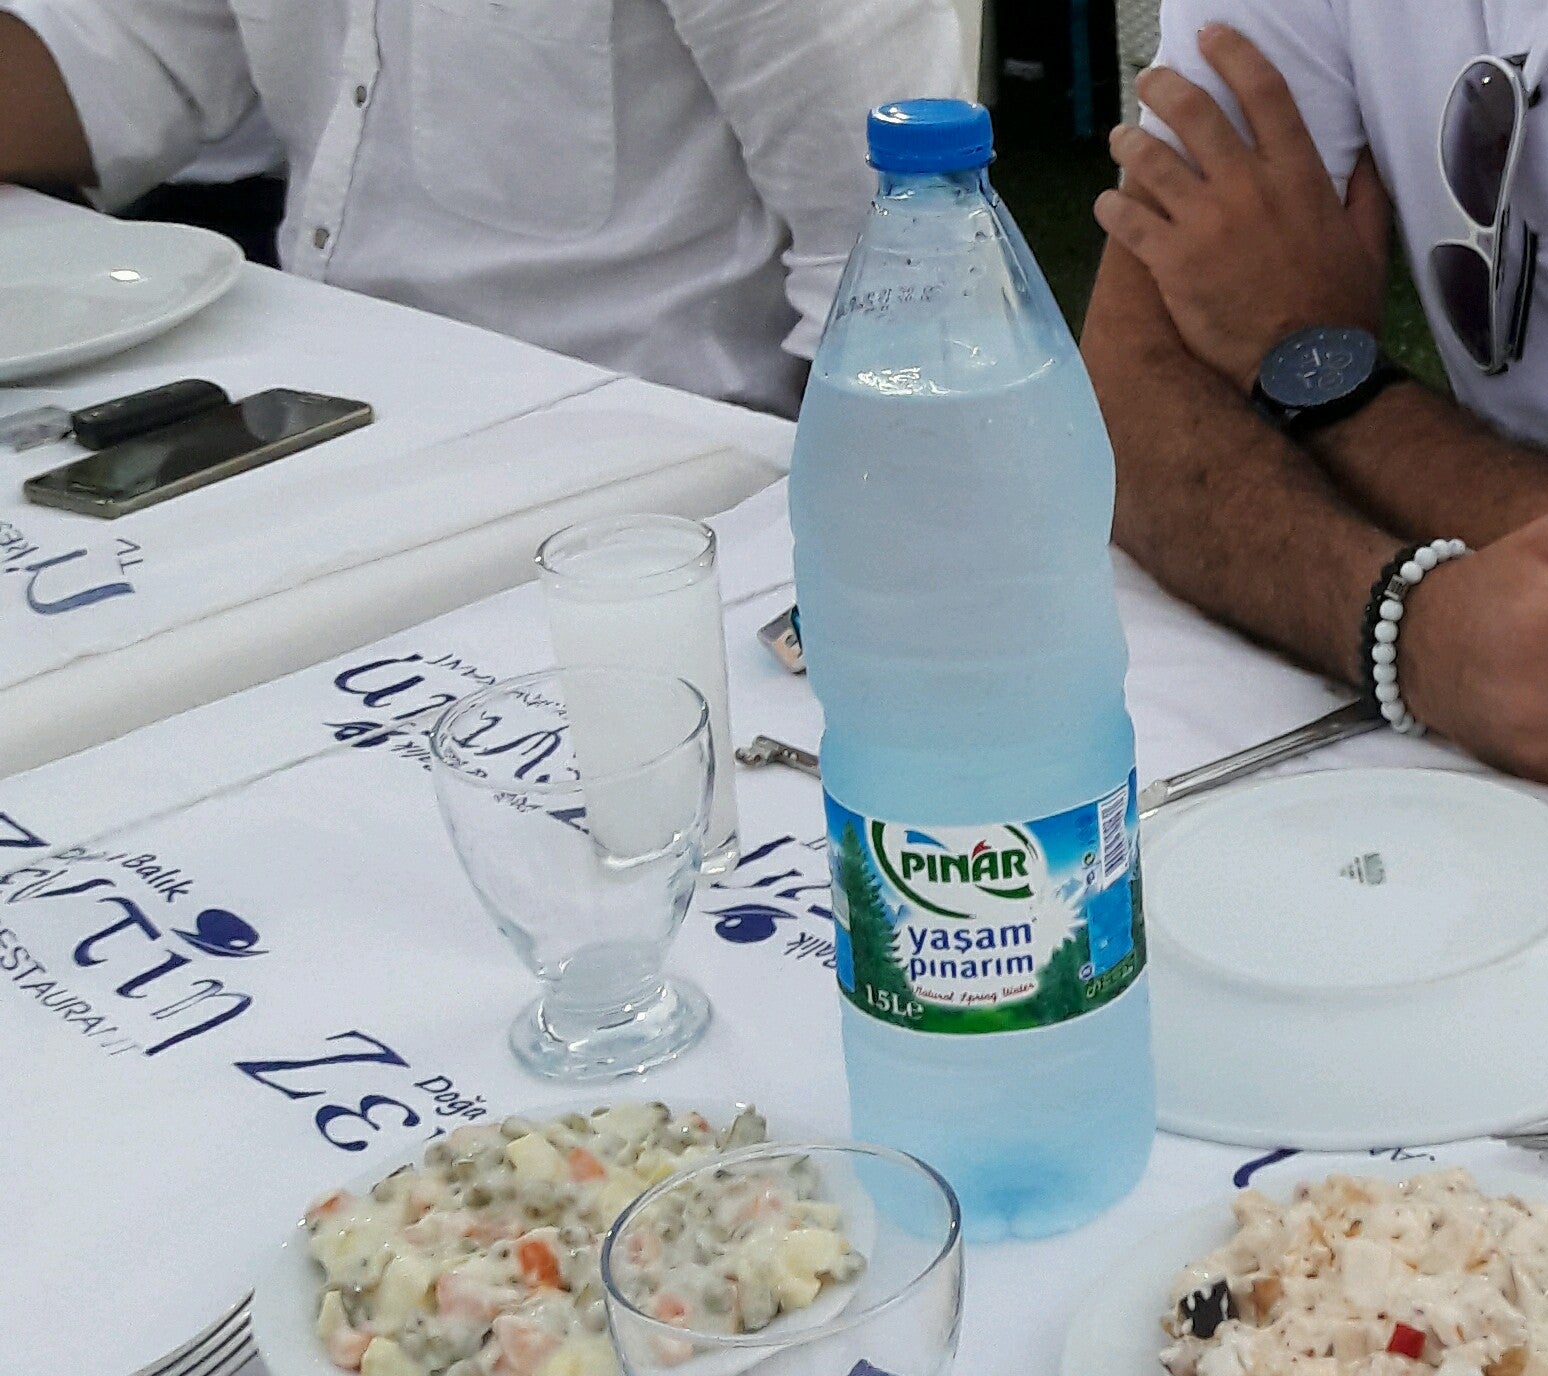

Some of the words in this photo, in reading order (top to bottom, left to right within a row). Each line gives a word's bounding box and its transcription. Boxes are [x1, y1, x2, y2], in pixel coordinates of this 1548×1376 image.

[121, 852, 194, 904] Balık
[901, 847, 1030, 884] PINAR
[907, 922, 1033, 956] yaşam
[909, 953, 1034, 981] pınarım
[414, 1074, 488, 1122] Doğa
